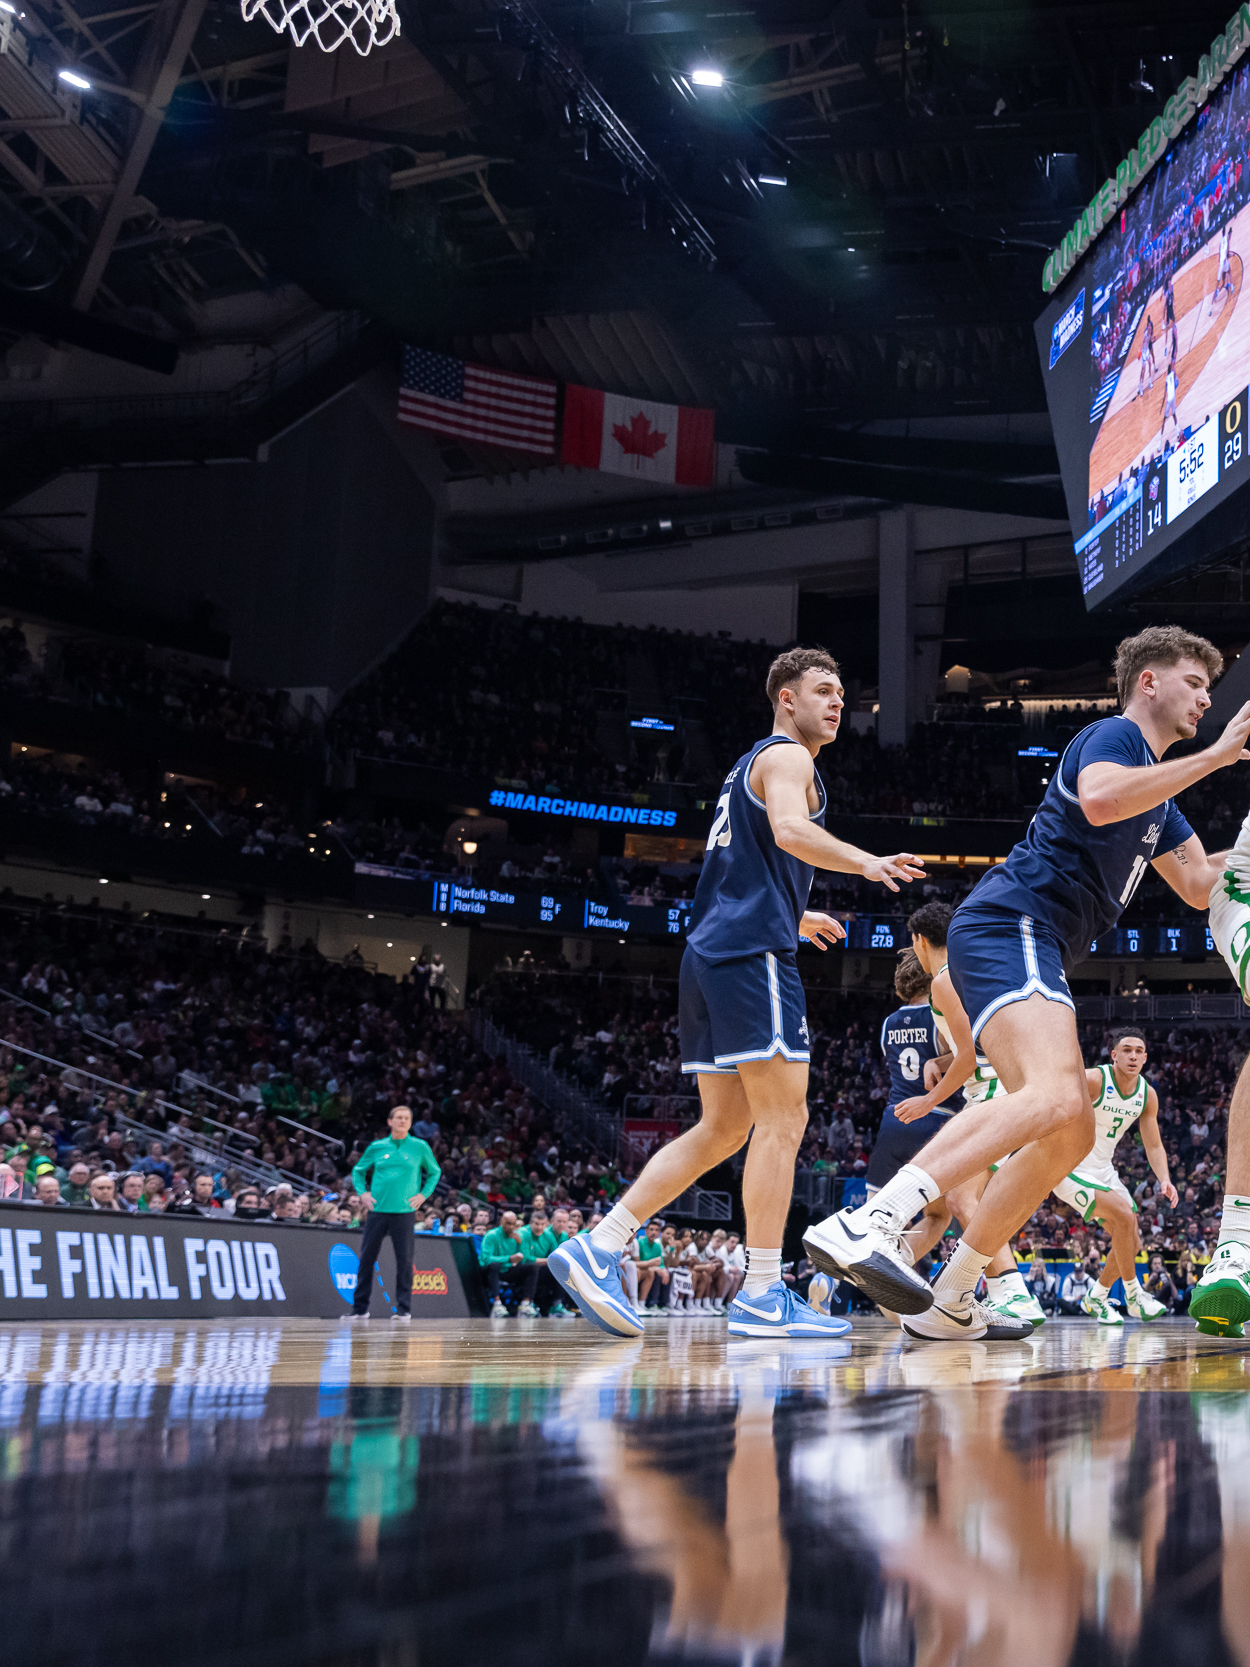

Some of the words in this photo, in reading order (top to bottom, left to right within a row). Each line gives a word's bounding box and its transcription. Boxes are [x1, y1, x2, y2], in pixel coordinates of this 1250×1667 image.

[1042, 177, 1117, 292] CLIMATE
[1116, 75, 1197, 201] PLEDGE
[1224, 432, 1242, 470] 29
[1179, 442, 1204, 484] 5:52
[1147, 501, 1162, 536] 14
[489, 790, 677, 827] #MARCHMADNESS
[454, 886, 488, 901] Norfolk
[490, 890, 515, 904] State
[540, 896, 554, 908] 69
[554, 903, 561, 915] F
[454, 900, 486, 914] Florida
[540, 909, 553, 921] 95
[588, 915, 629, 932] Kentucky
[668, 922, 680, 933] 76
[590, 902, 608, 917] Troy
[668, 909, 680, 921] 57
[684, 916, 690, 927] F
[876, 925, 890, 934] FG%
[1127, 930, 1140, 938] STL
[1167, 929, 1180, 938] BLK
[870, 935, 893, 948] 27.8
[1130, 939, 1138, 952] 0
[1171, 938, 1178, 951] 1
[1206, 937, 1214, 950] 5
[888, 1028, 928, 1045] PORTER
[898, 1047, 920, 1081] 0
[1102, 1105, 1139, 1118] DUCKS
[1107, 1117, 1124, 1138] 3
[56, 1231, 179, 1300] FINAL
[184, 1238, 286, 1301] FOUR
[412, 1272, 446, 1290] eese's
